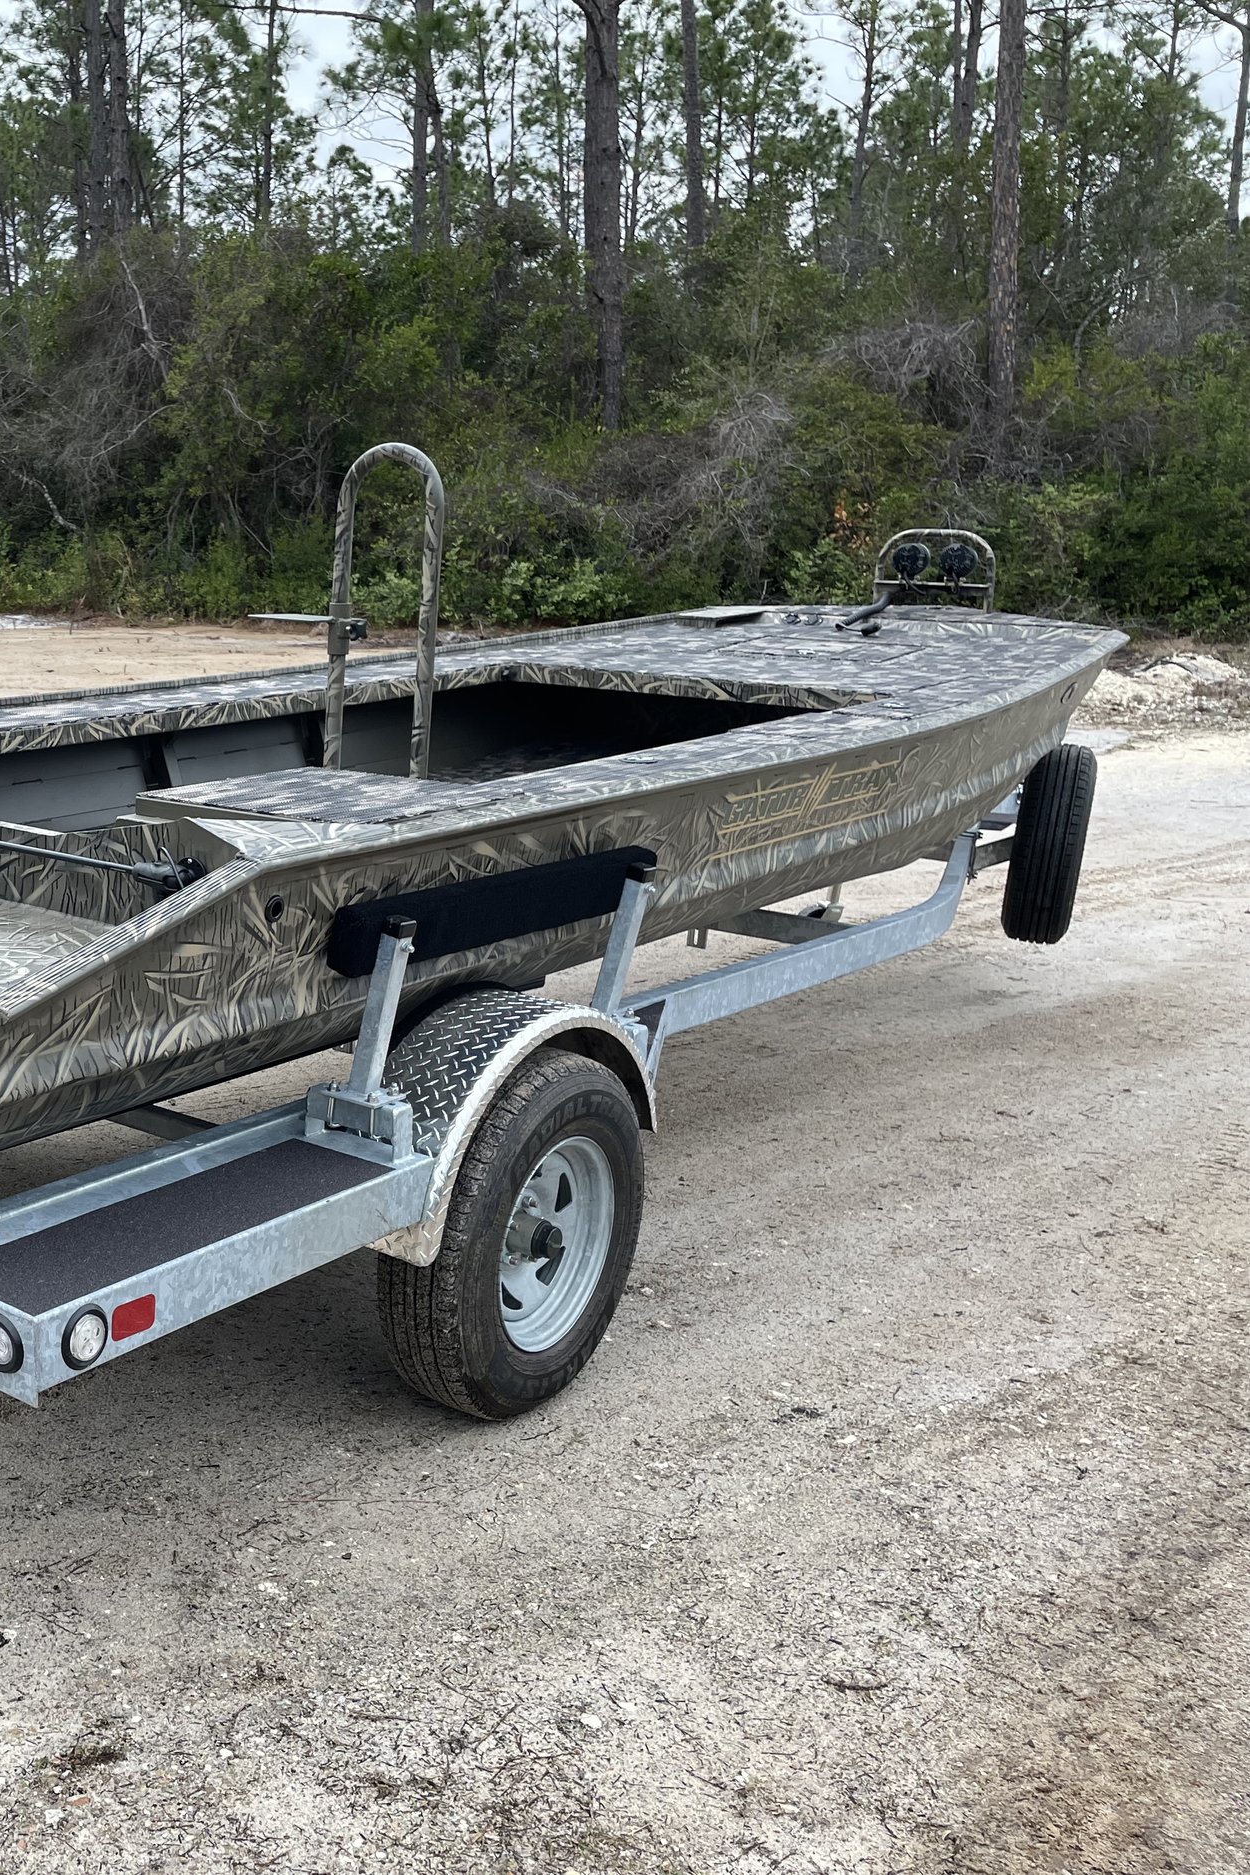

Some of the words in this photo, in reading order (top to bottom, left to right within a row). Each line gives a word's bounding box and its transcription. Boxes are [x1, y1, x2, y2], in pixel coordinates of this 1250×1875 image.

[722, 787, 809, 827] GATOR
[511, 1096, 588, 1187] RADIAL
[498, 1311, 609, 1401] CARLIS
